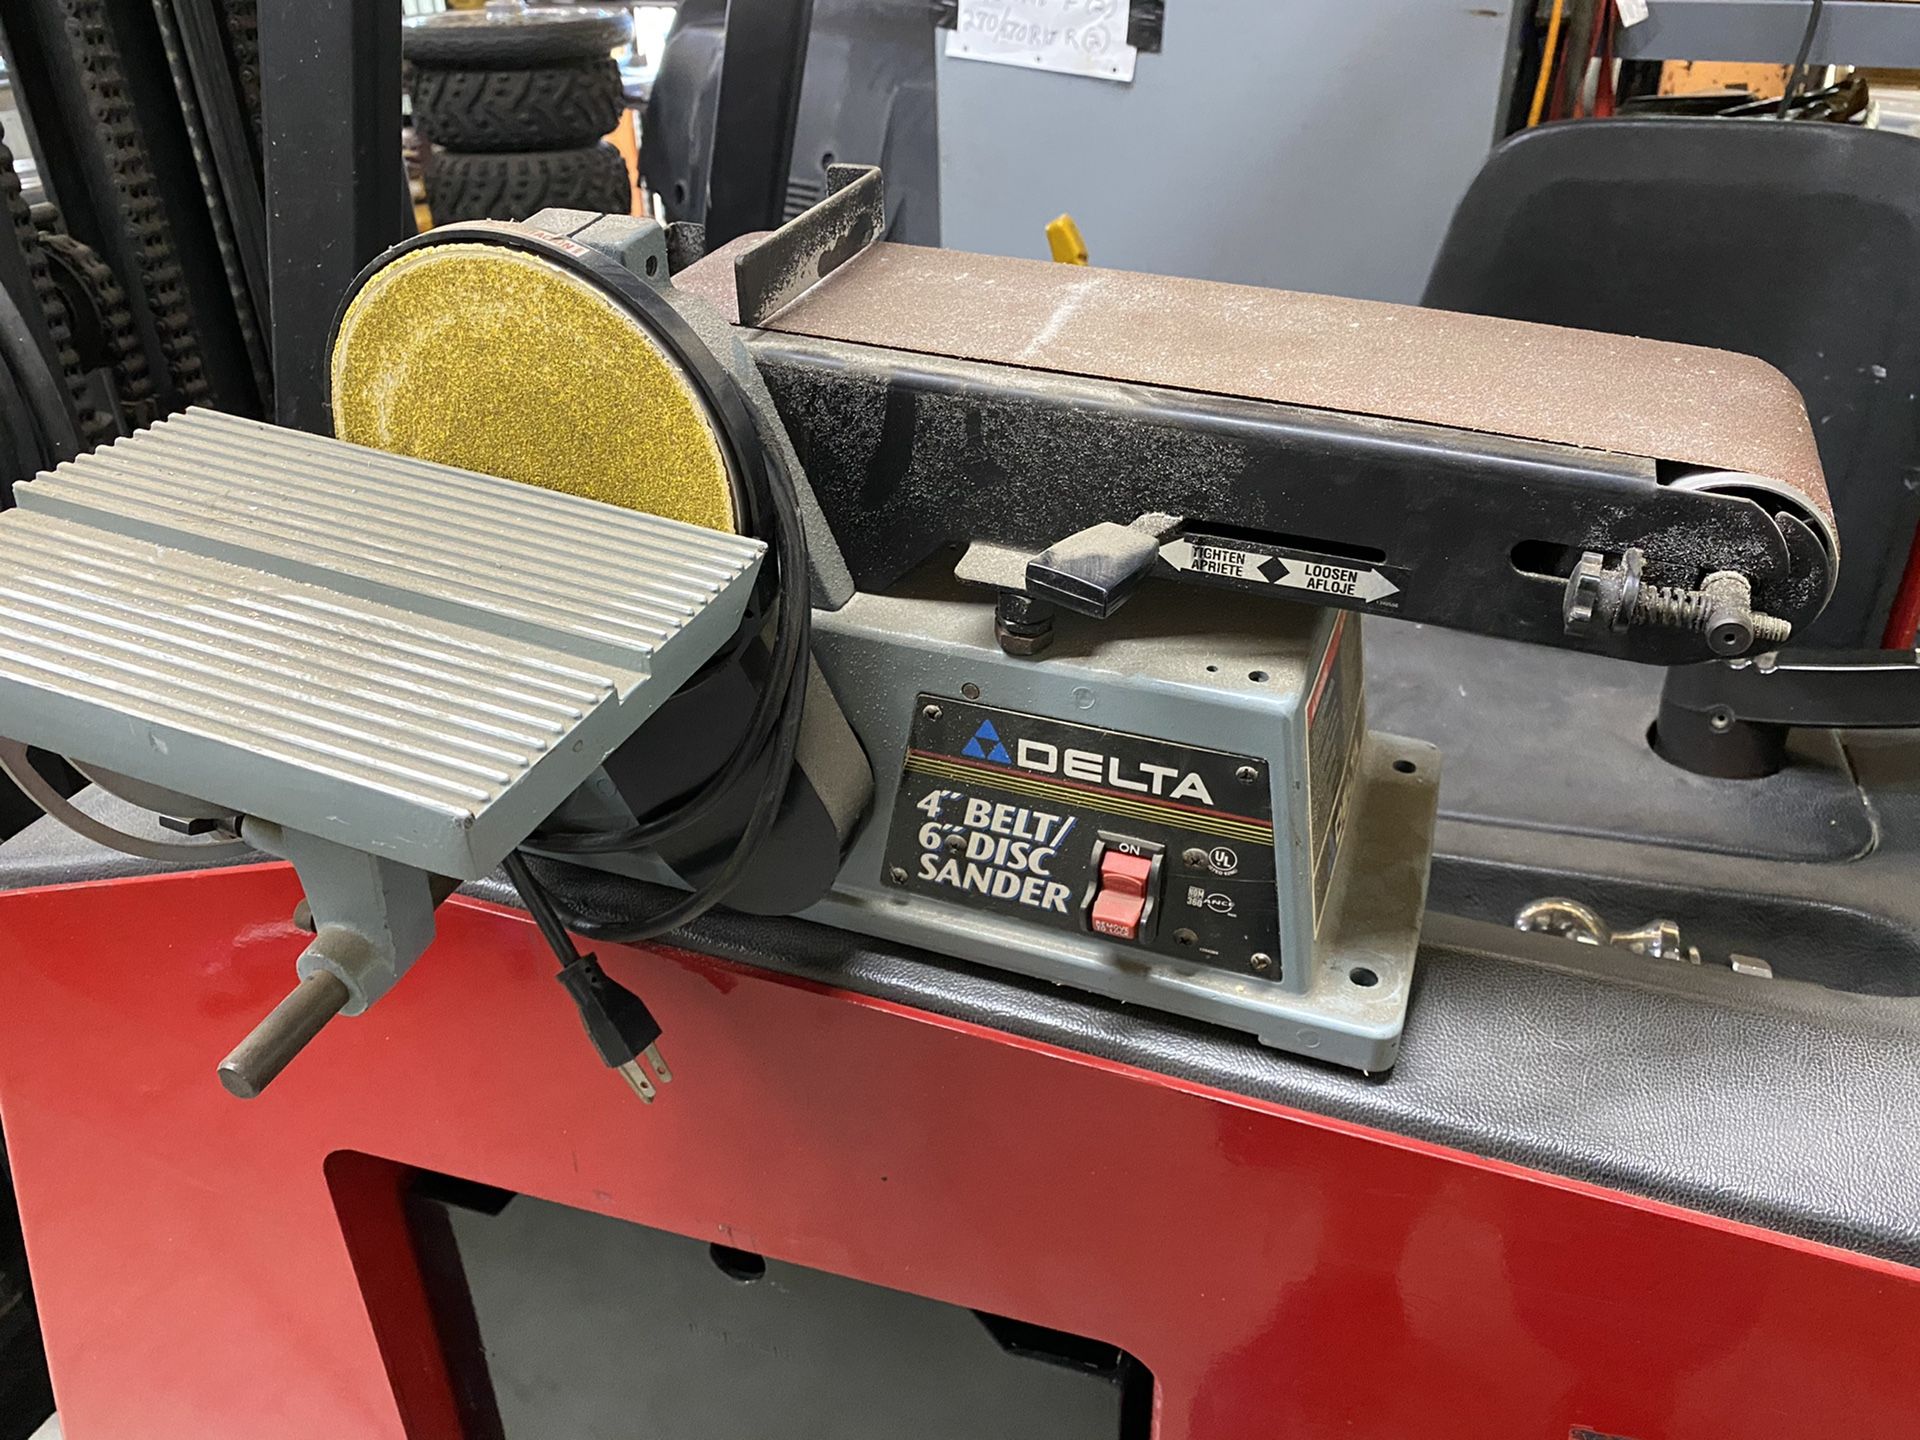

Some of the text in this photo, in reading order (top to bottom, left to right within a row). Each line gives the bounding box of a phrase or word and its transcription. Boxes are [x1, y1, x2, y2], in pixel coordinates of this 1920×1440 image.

[1191, 545, 1246, 565] TIGHTEN
[1191, 559, 1244, 578] APRIETE
[1305, 564, 1358, 584] LOOSEN
[1306, 577, 1356, 596] AFLOJE
[1016, 738, 1214, 806] DELTA
[963, 797, 1077, 848] BELT/
[965, 831, 1056, 876] DISC
[1119, 842, 1140, 855] ON
[1215, 850, 1231, 868] UL
[917, 853, 1072, 914] SANDER
